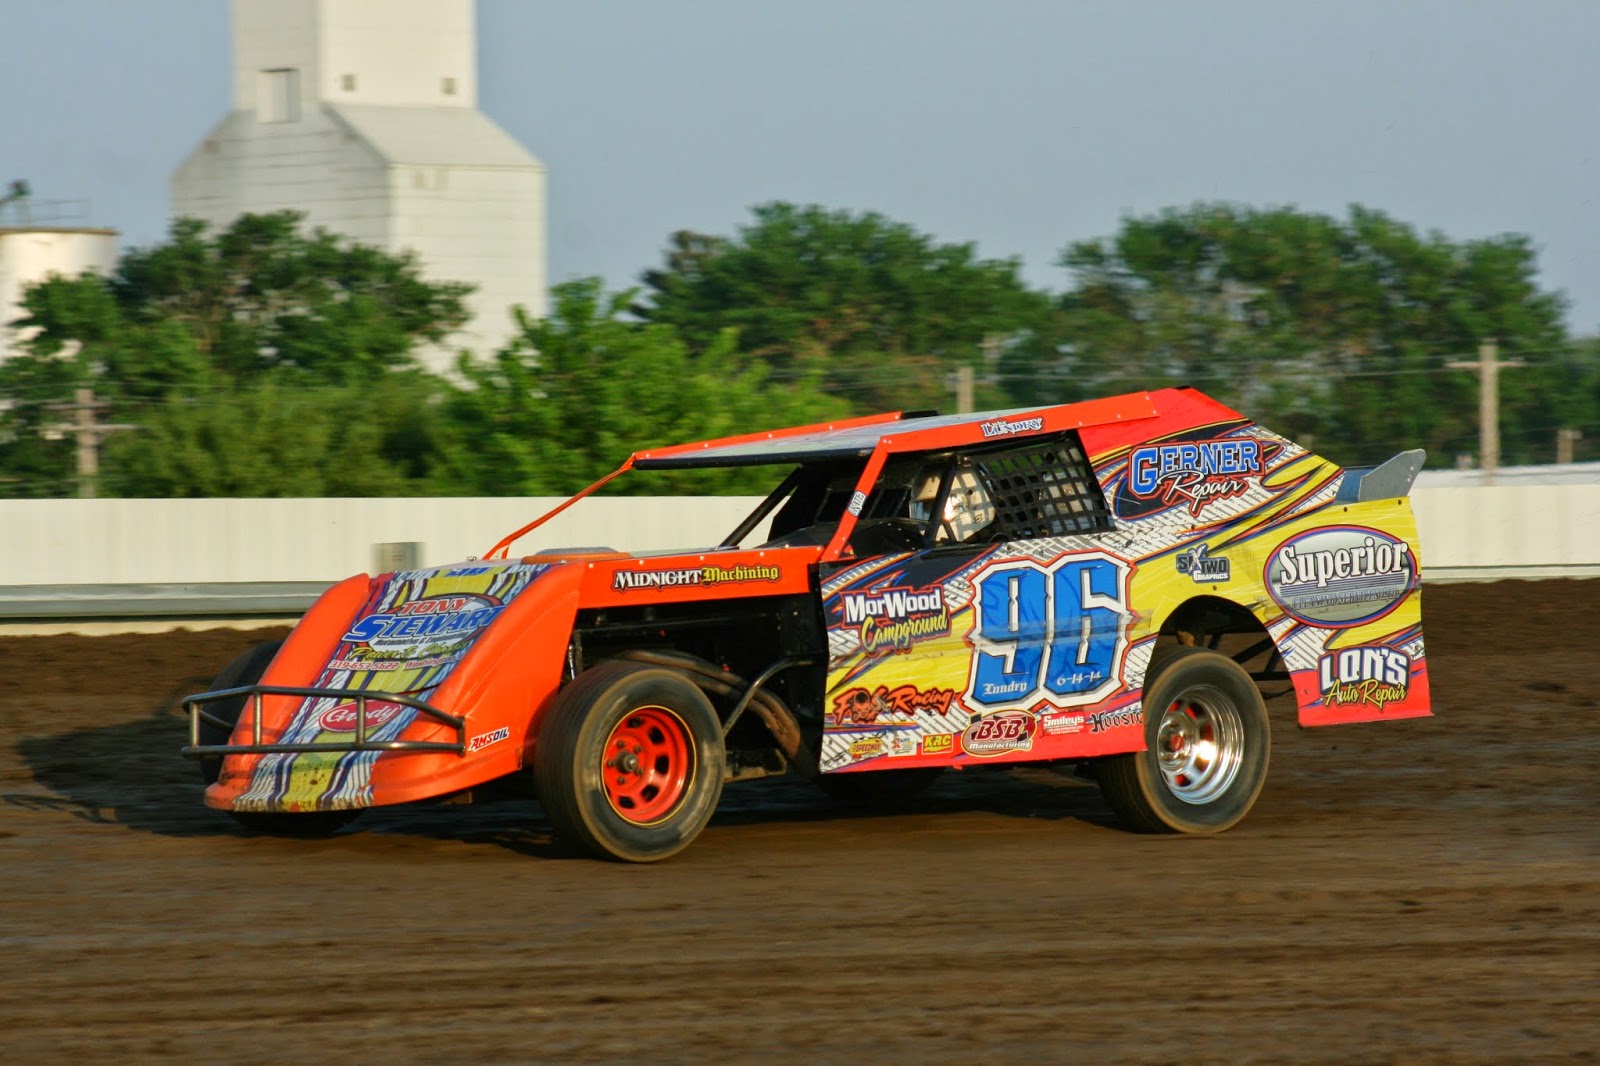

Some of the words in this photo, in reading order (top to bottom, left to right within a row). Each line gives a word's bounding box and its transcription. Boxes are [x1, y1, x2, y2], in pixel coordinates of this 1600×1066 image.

[981, 418, 1042, 436] LUNDRY
[1132, 441, 1259, 494] GERNER
[1157, 470, 1242, 511] Repair
[1279, 537, 1408, 587] Superior
[614, 570, 702, 589] MIDNIGHT
[701, 566, 779, 584] Machining
[400, 597, 476, 615] TONY
[844, 588, 941, 622] MorWood
[342, 605, 506, 641] STEWART
[861, 605, 948, 651] Campground
[973, 558, 1119, 704] 96
[887, 685, 953, 715] Racing
[982, 681, 1028, 696] Lundry
[1325, 679, 1359, 706] Auto
[1359, 679, 1407, 708] Repair
[471, 729, 507, 750] AMSOIL
[976, 718, 1024, 741] BSB
[969, 740, 1031, 750] Manufacturing
